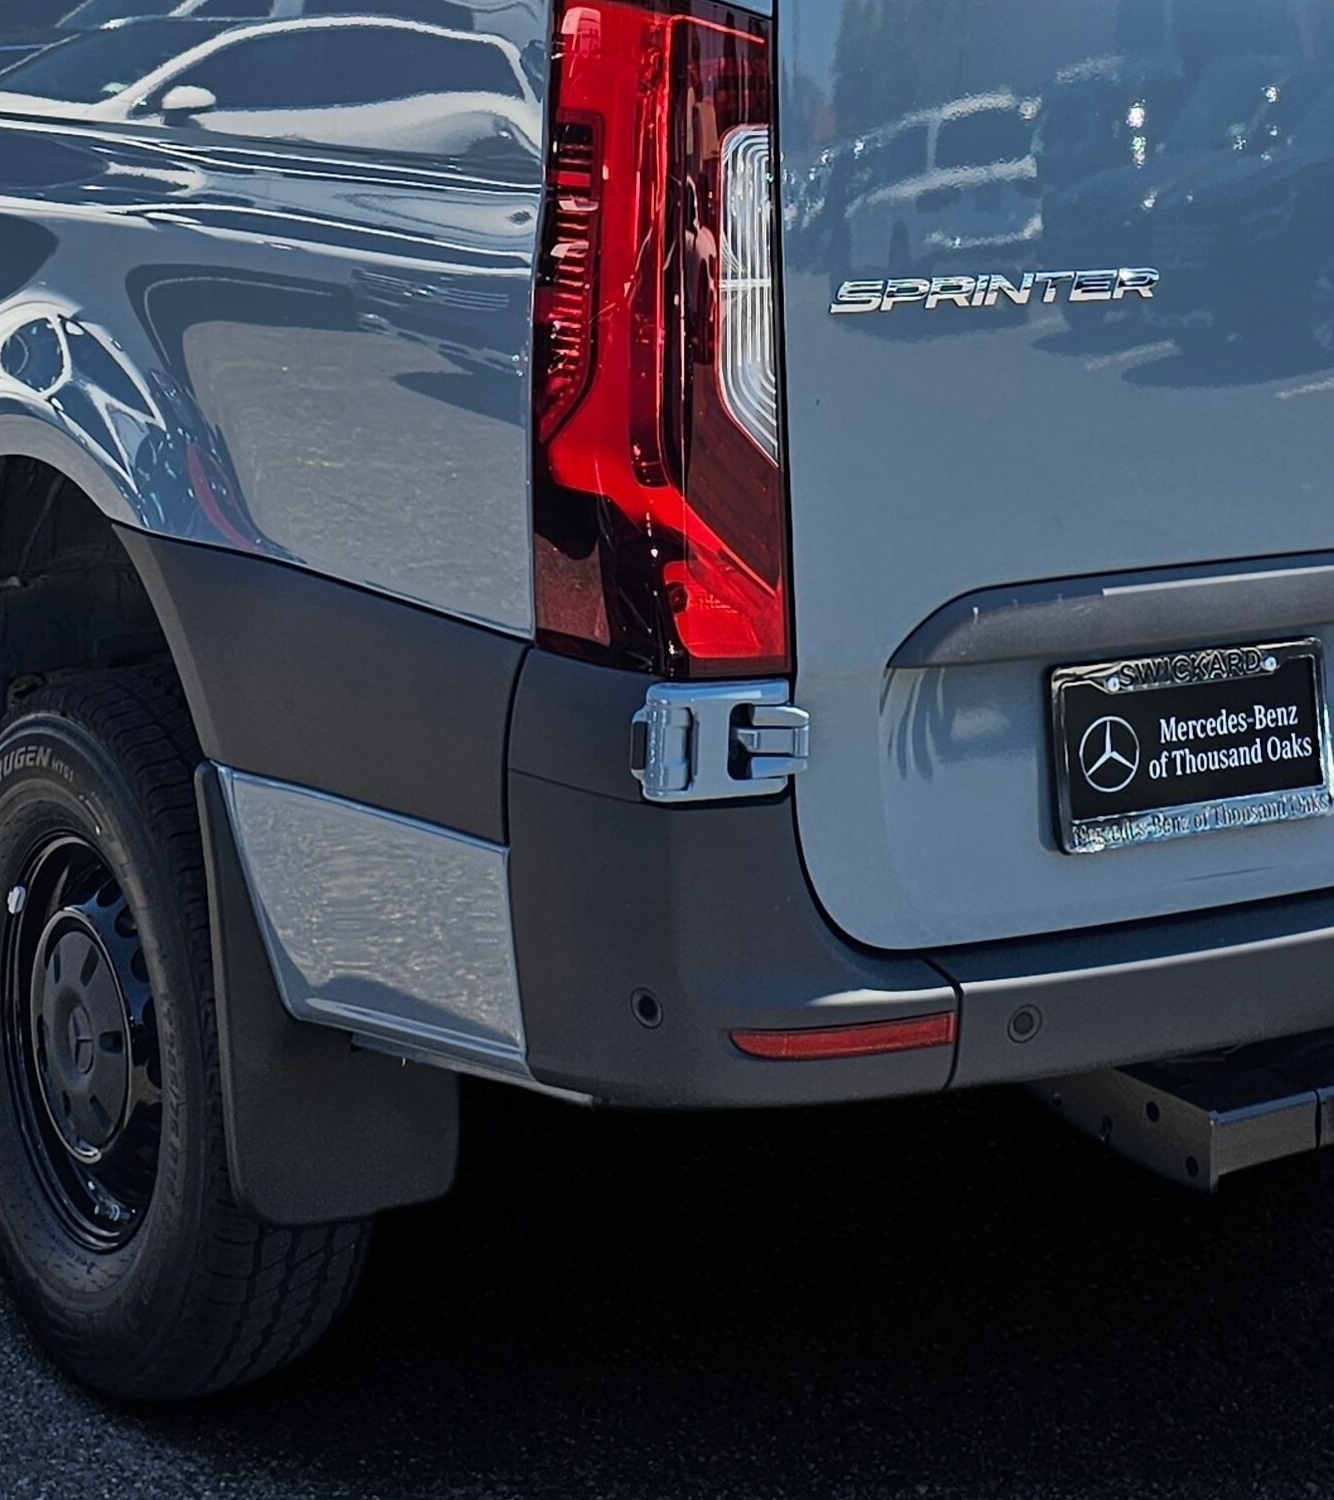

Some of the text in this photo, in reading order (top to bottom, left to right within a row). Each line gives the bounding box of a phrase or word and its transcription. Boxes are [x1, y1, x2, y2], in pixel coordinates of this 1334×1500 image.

[829, 267, 1160, 315] SPRINTER
[1119, 648, 1262, 687] SWICKARD
[1159, 704, 1298, 744] Mercedes-Benz
[1148, 732, 1312, 779] of Thousand Oaks
